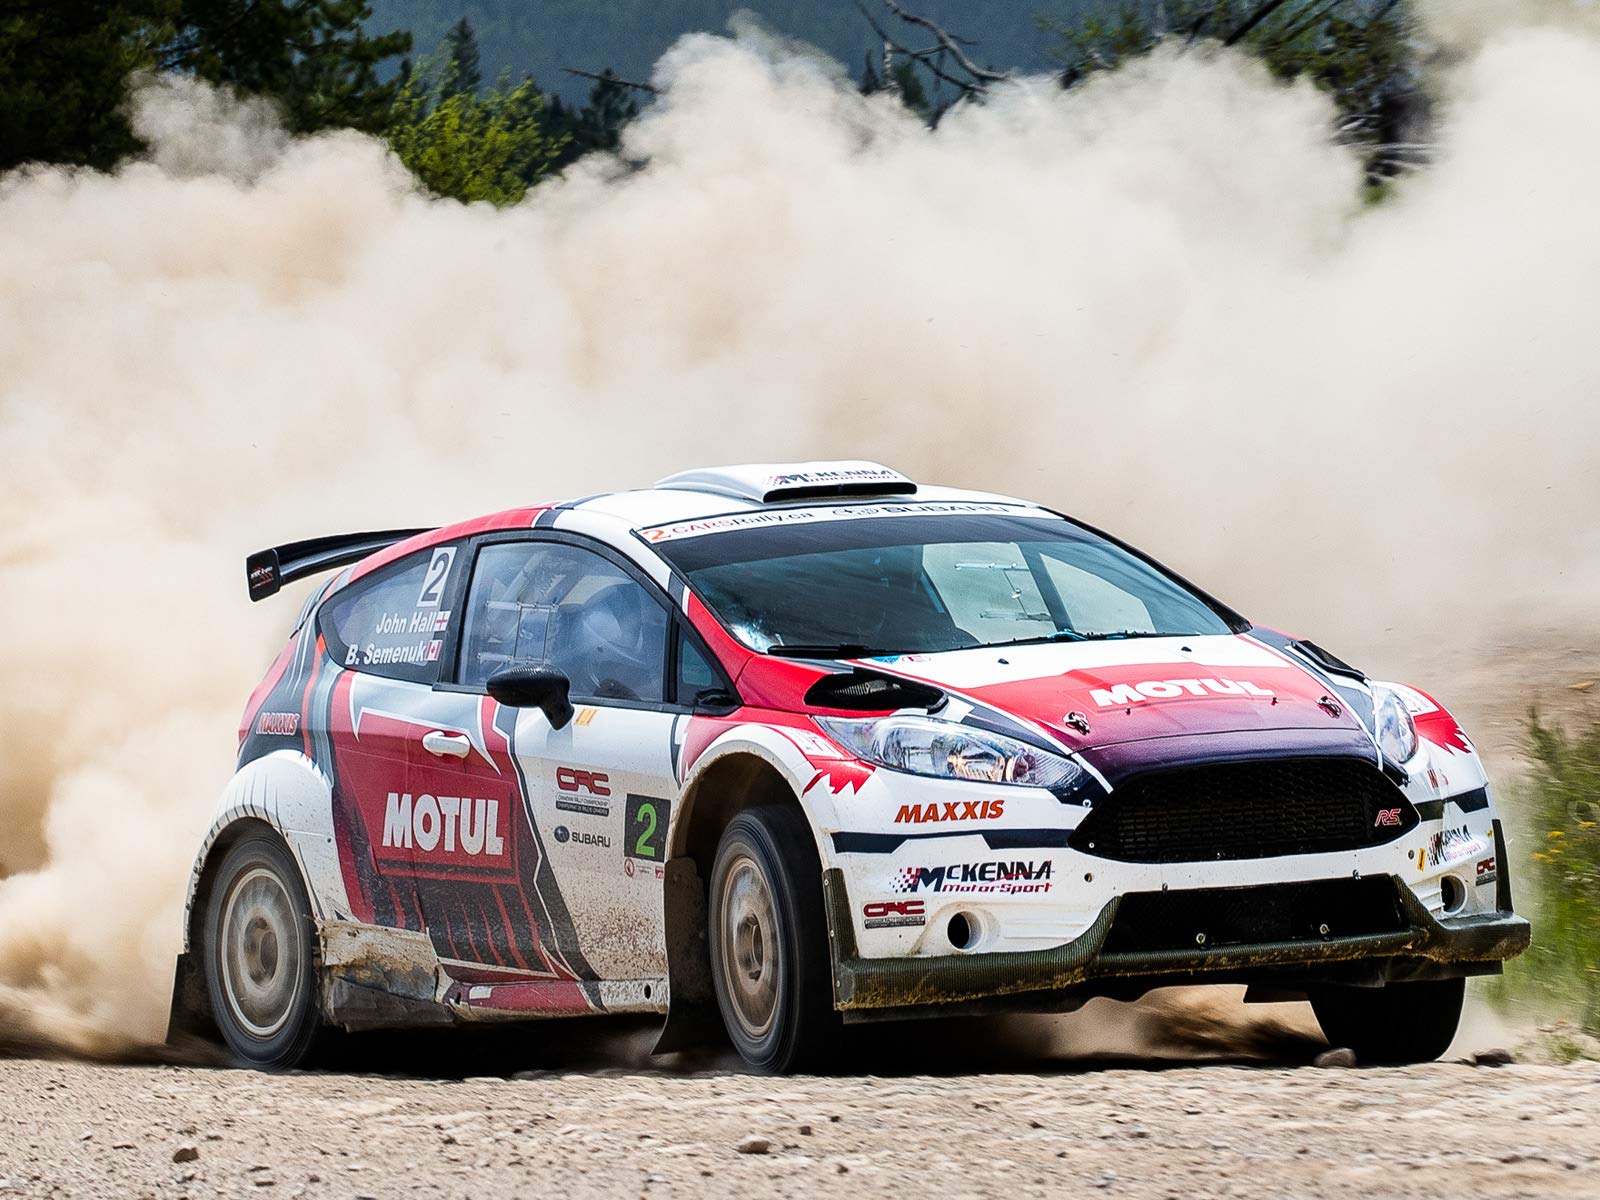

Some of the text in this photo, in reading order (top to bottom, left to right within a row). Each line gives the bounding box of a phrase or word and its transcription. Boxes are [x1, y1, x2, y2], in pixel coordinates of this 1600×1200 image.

[643, 529, 671, 541] 2
[420, 552, 450, 603] 2
[376, 612, 435, 634] John Hall
[345, 641, 427, 665] B. Semenuk
[1089, 678, 1275, 707] MOTUL
[256, 712, 300, 736] MAXXIS
[382, 792, 504, 855] MOTUL
[894, 800, 1005, 824] MAXXIS
[1374, 808, 1402, 827] RS
[571, 831, 611, 848] SUBARU
[635, 803, 657, 857] 2
